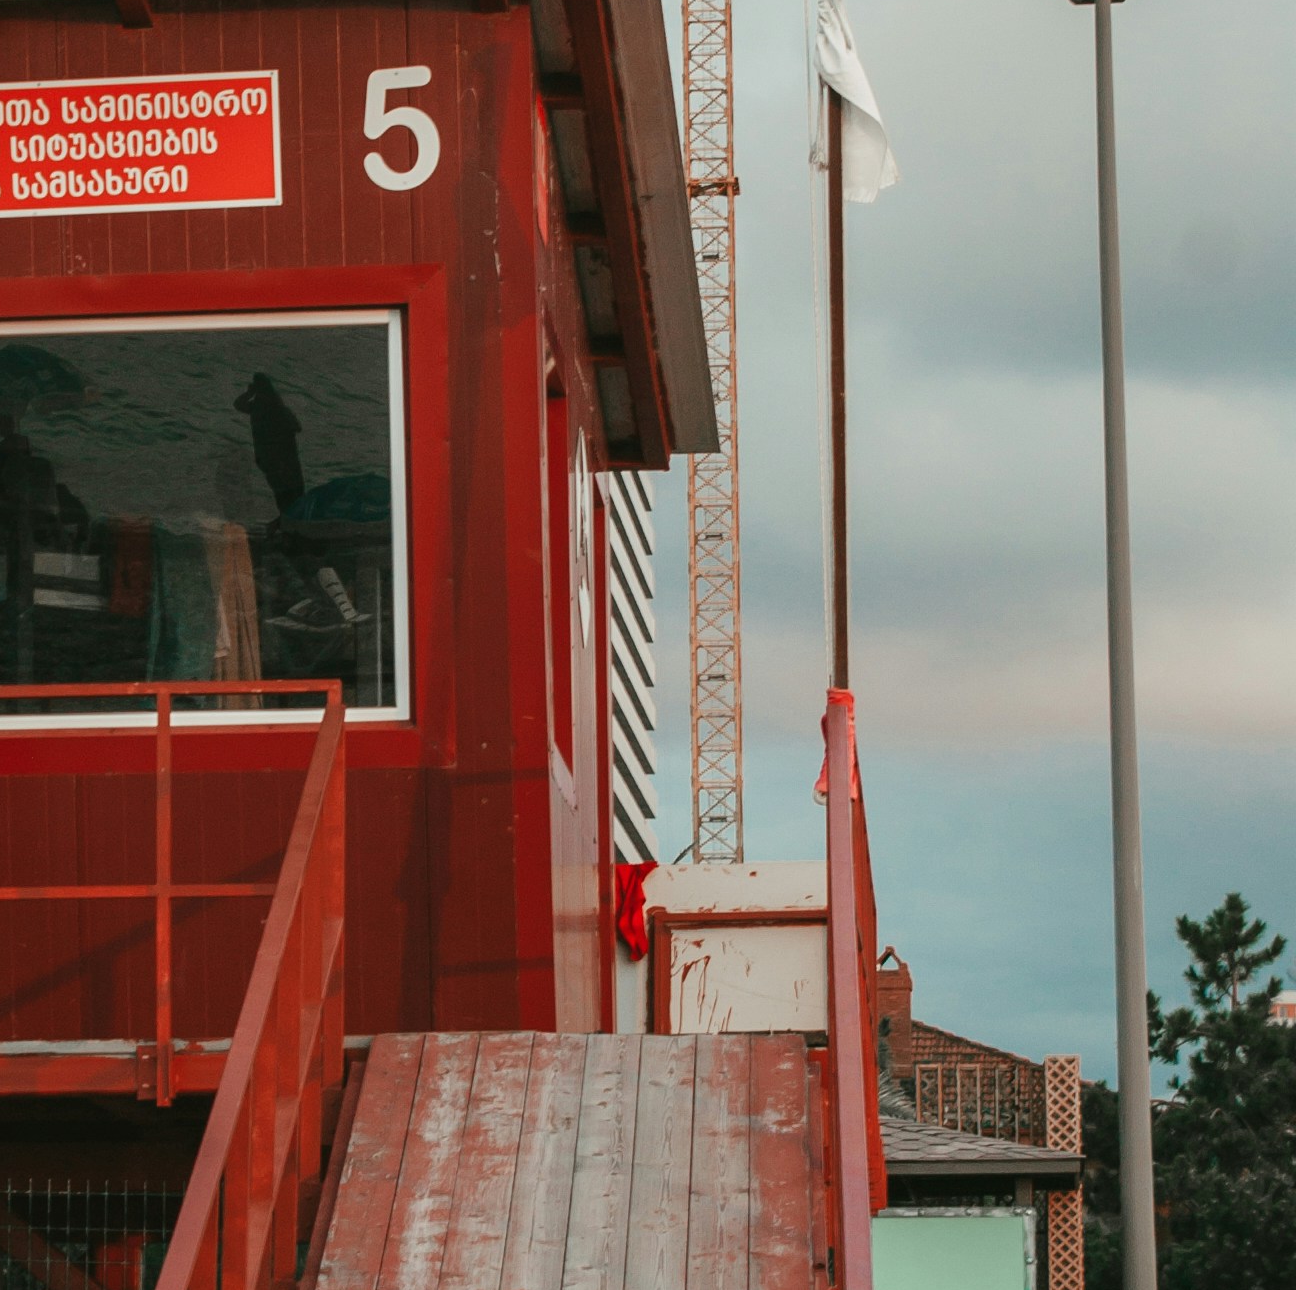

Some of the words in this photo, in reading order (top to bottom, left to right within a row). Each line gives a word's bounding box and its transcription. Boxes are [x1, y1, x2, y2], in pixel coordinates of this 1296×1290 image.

[61, 87, 269, 124] სამინისტრო
[9, 126, 219, 163] სიტუაციების
[363, 65, 440, 191] 5
[11, 164, 190, 200] სამსახური
